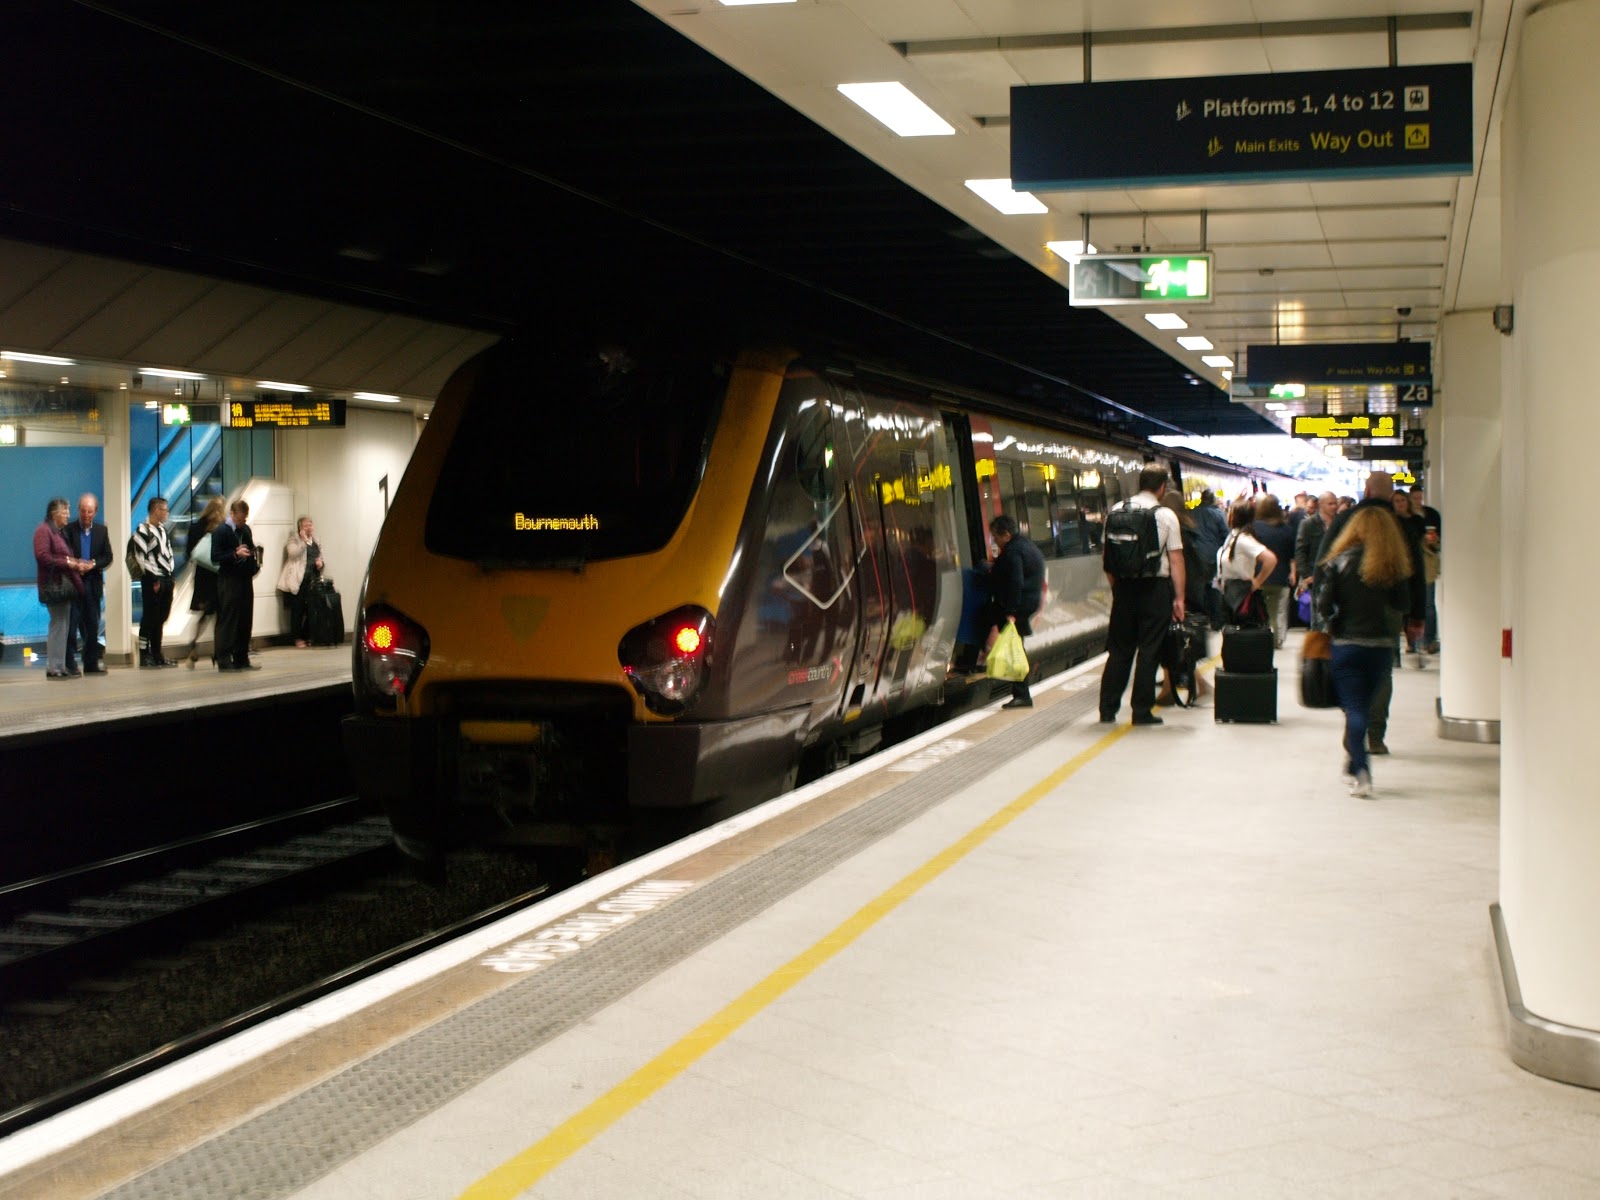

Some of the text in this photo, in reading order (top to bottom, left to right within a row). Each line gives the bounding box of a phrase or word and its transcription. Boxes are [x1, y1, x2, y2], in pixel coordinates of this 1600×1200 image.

[1203, 89, 1395, 118] Platforms 1, 4 to 12
[1234, 128, 1394, 154] Main Exits Way Out
[514, 511, 599, 530] Bournemouth
